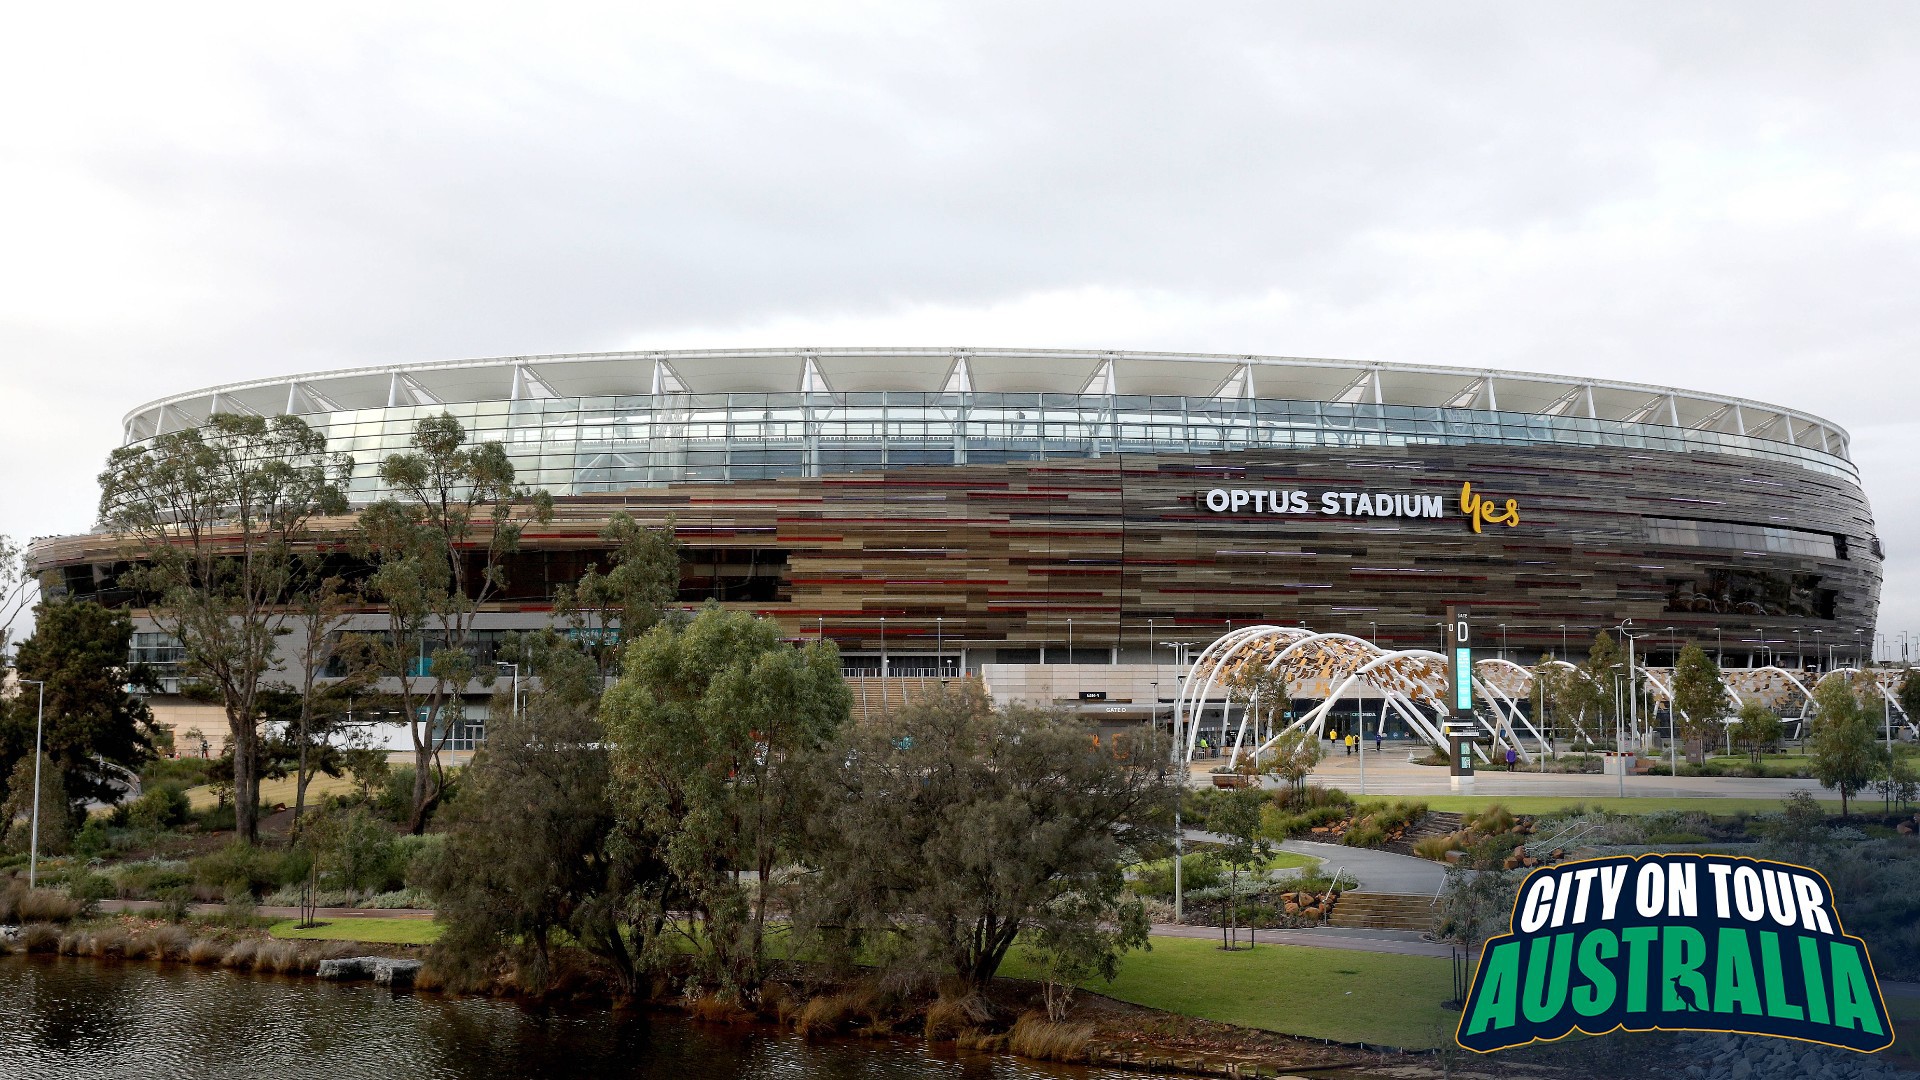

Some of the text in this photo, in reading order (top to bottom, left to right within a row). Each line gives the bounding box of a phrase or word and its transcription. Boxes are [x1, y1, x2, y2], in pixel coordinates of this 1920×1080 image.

[1206, 488, 1309, 514] OPTUS
[1320, 491, 1443, 518] STADIUM
[1457, 621, 1469, 642] D
